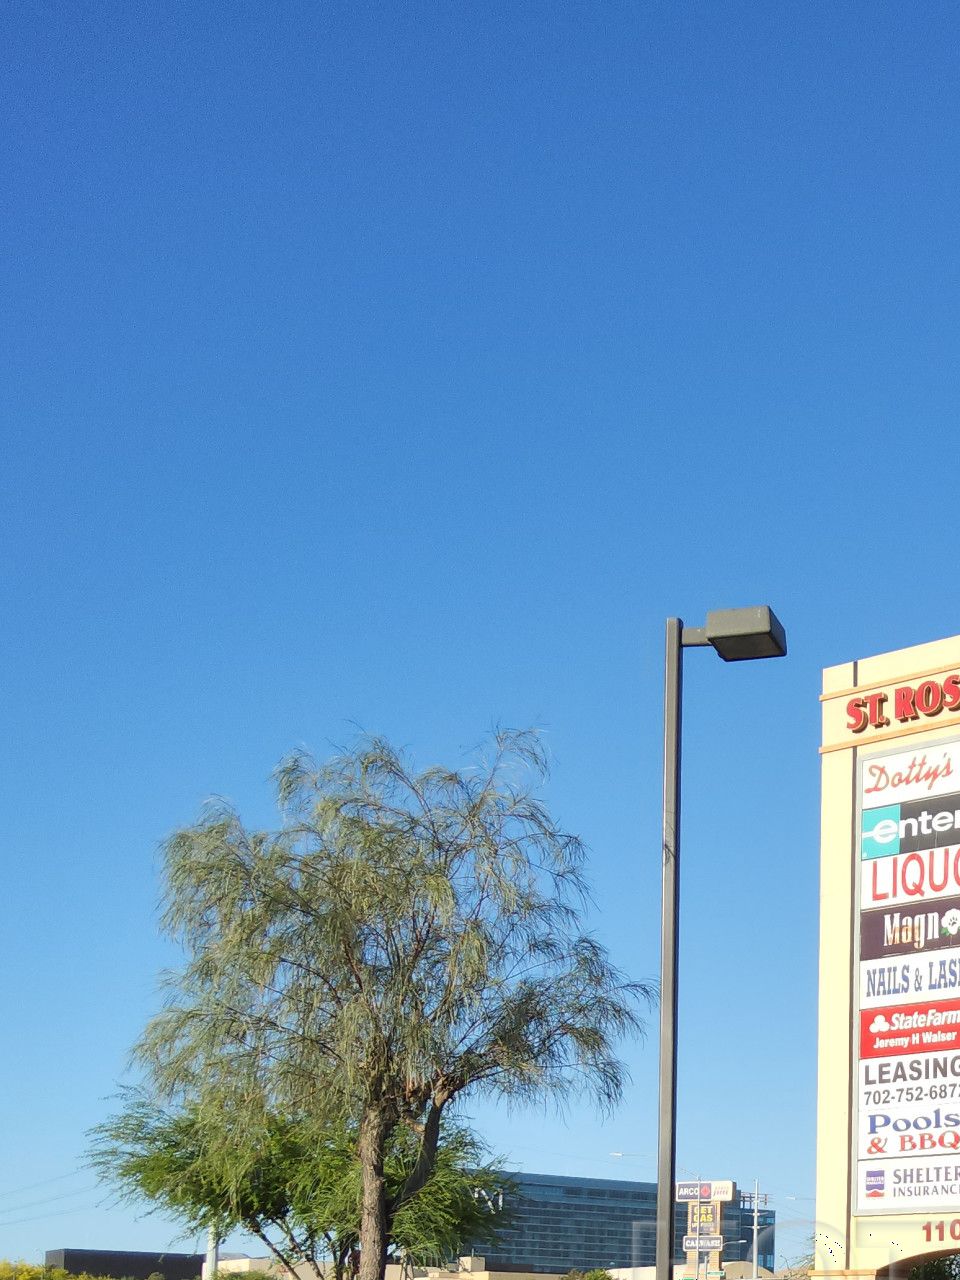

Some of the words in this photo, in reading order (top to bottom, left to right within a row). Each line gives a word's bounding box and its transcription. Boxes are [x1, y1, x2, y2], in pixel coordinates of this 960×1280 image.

[847, 691, 889, 733] ST.
[865, 752, 953, 794] Dotty's
[866, 964, 910, 998] NAILS
[914, 970, 923, 991] &
[873, 1036, 910, 1049] Jeremy
[911, 1033, 920, 1045] H
[867, 1108, 960, 1135] Pools
[866, 1136, 887, 1155] &
[900, 1129, 960, 1152] BBQ
[678, 1187, 699, 1196] ARCO
